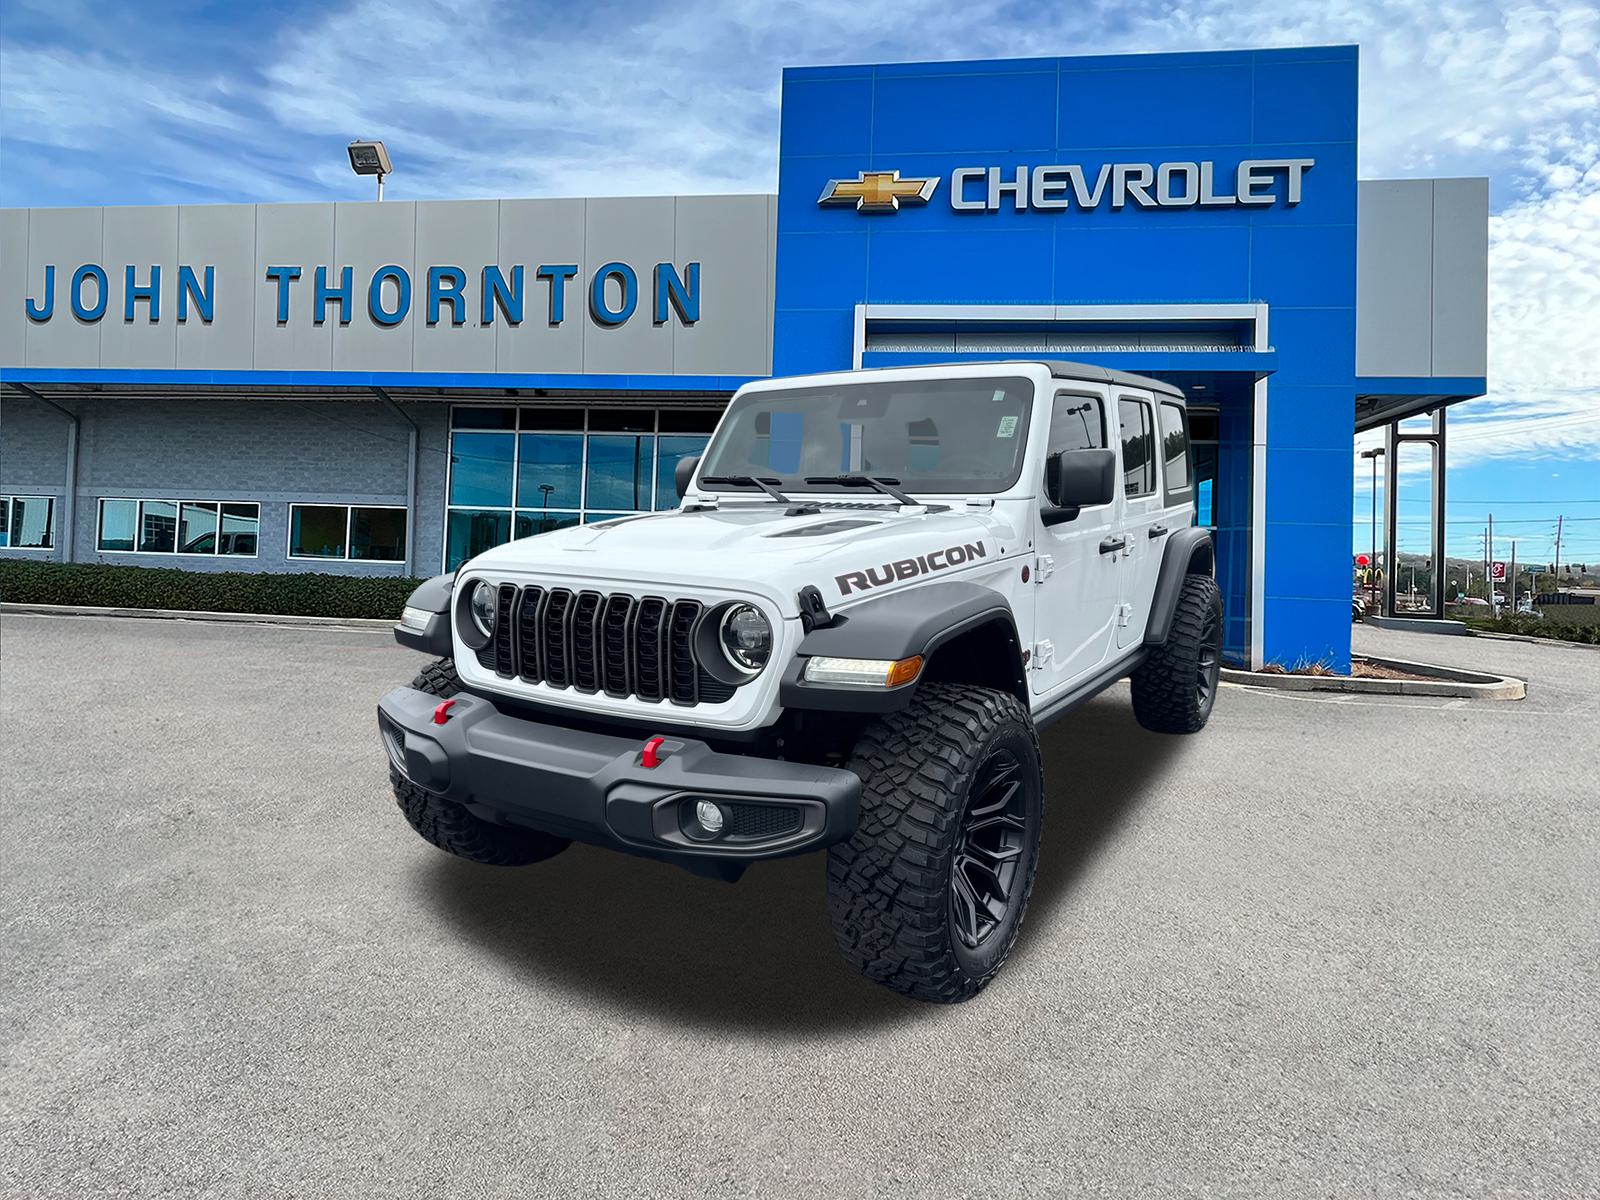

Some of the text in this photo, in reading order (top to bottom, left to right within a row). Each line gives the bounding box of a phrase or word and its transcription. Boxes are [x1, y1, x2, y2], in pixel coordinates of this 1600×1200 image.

[950, 158, 1315, 212] CHEVROLET
[25, 262, 701, 327] JOHN THORNTON
[834, 540, 986, 596] RUBICON
